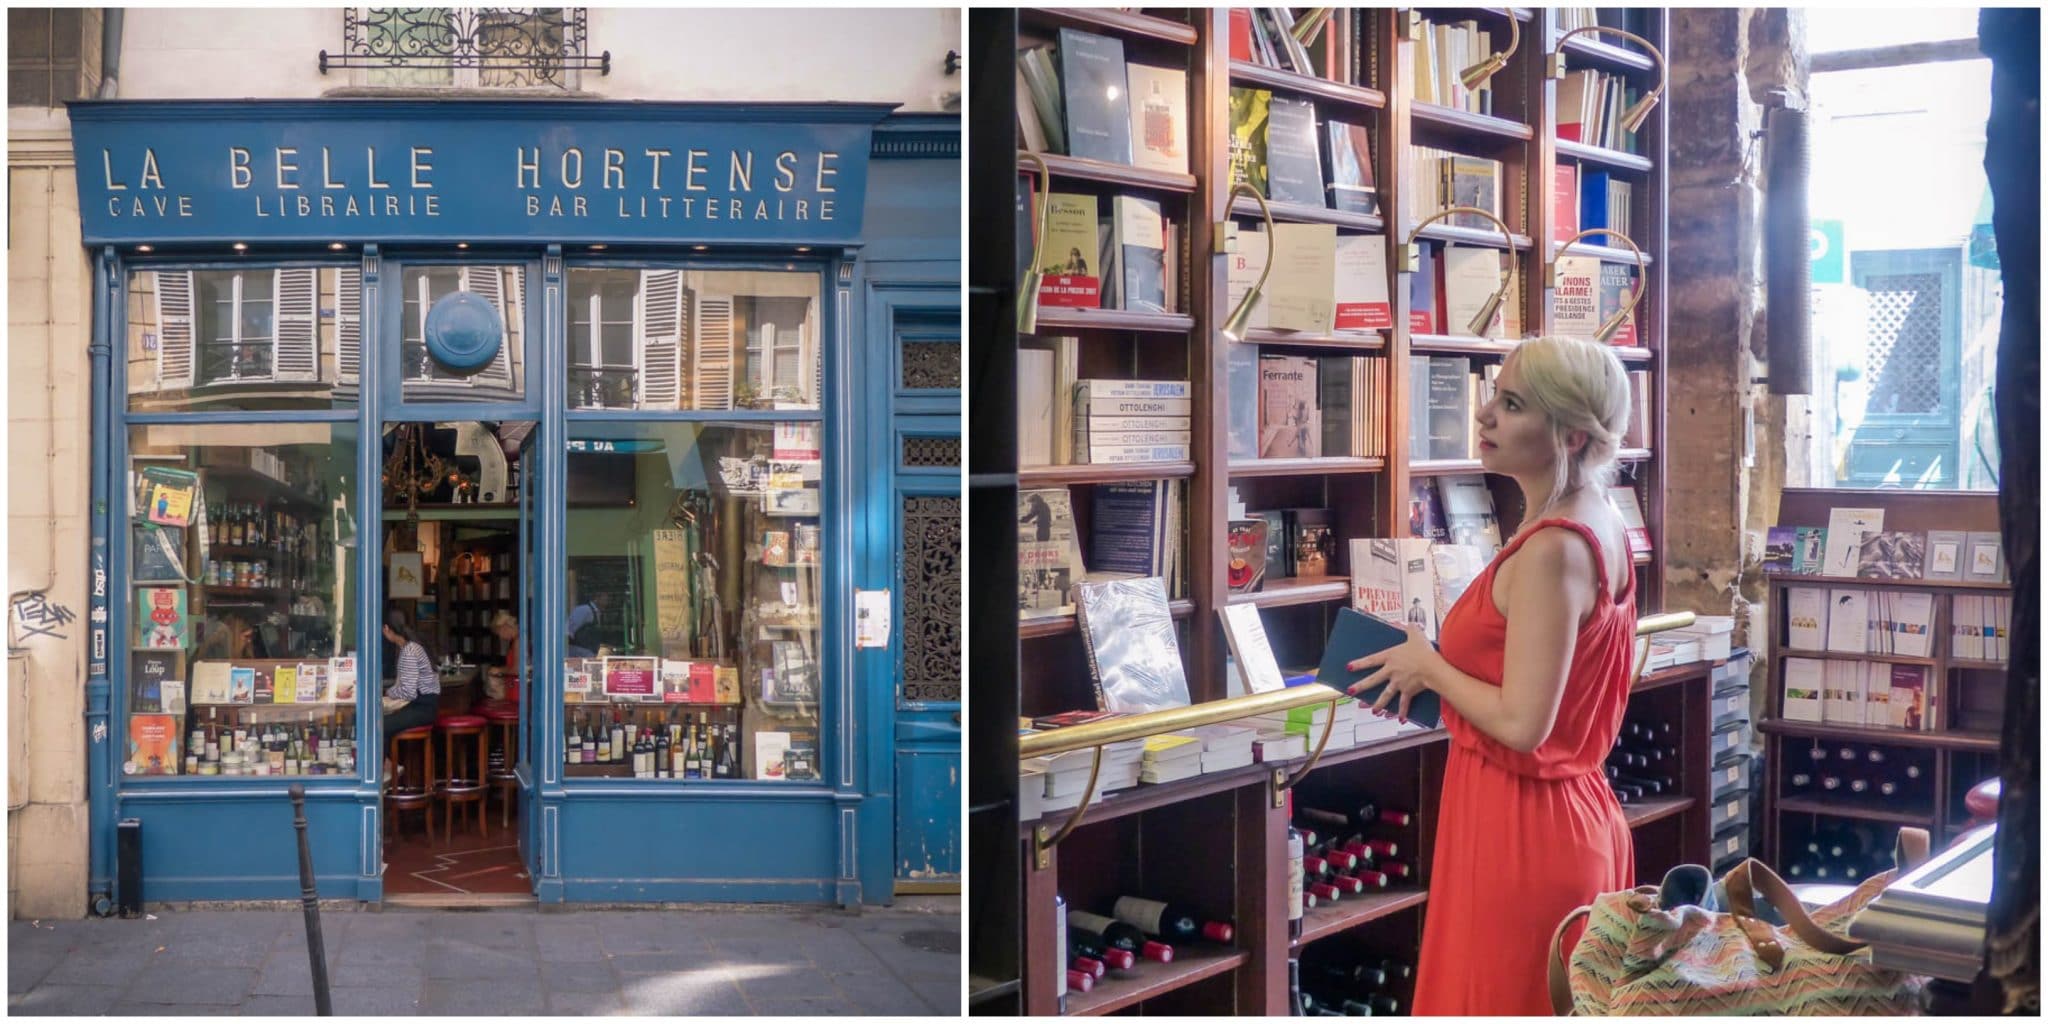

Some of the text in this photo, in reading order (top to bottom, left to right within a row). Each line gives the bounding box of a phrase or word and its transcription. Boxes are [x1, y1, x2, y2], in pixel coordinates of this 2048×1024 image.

[102, 147, 839, 193] LA BELLE HORTENSE
[108, 195, 837, 221] CAVE LIBRAIRIE BAR LITTERAIRE
[1600, 265, 1627, 276] AREK
[1600, 276, 1629, 288] ALTER
[1263, 370, 1304, 382] Ferrante
[1119, 403, 1166, 412] OTTOLENGHI
